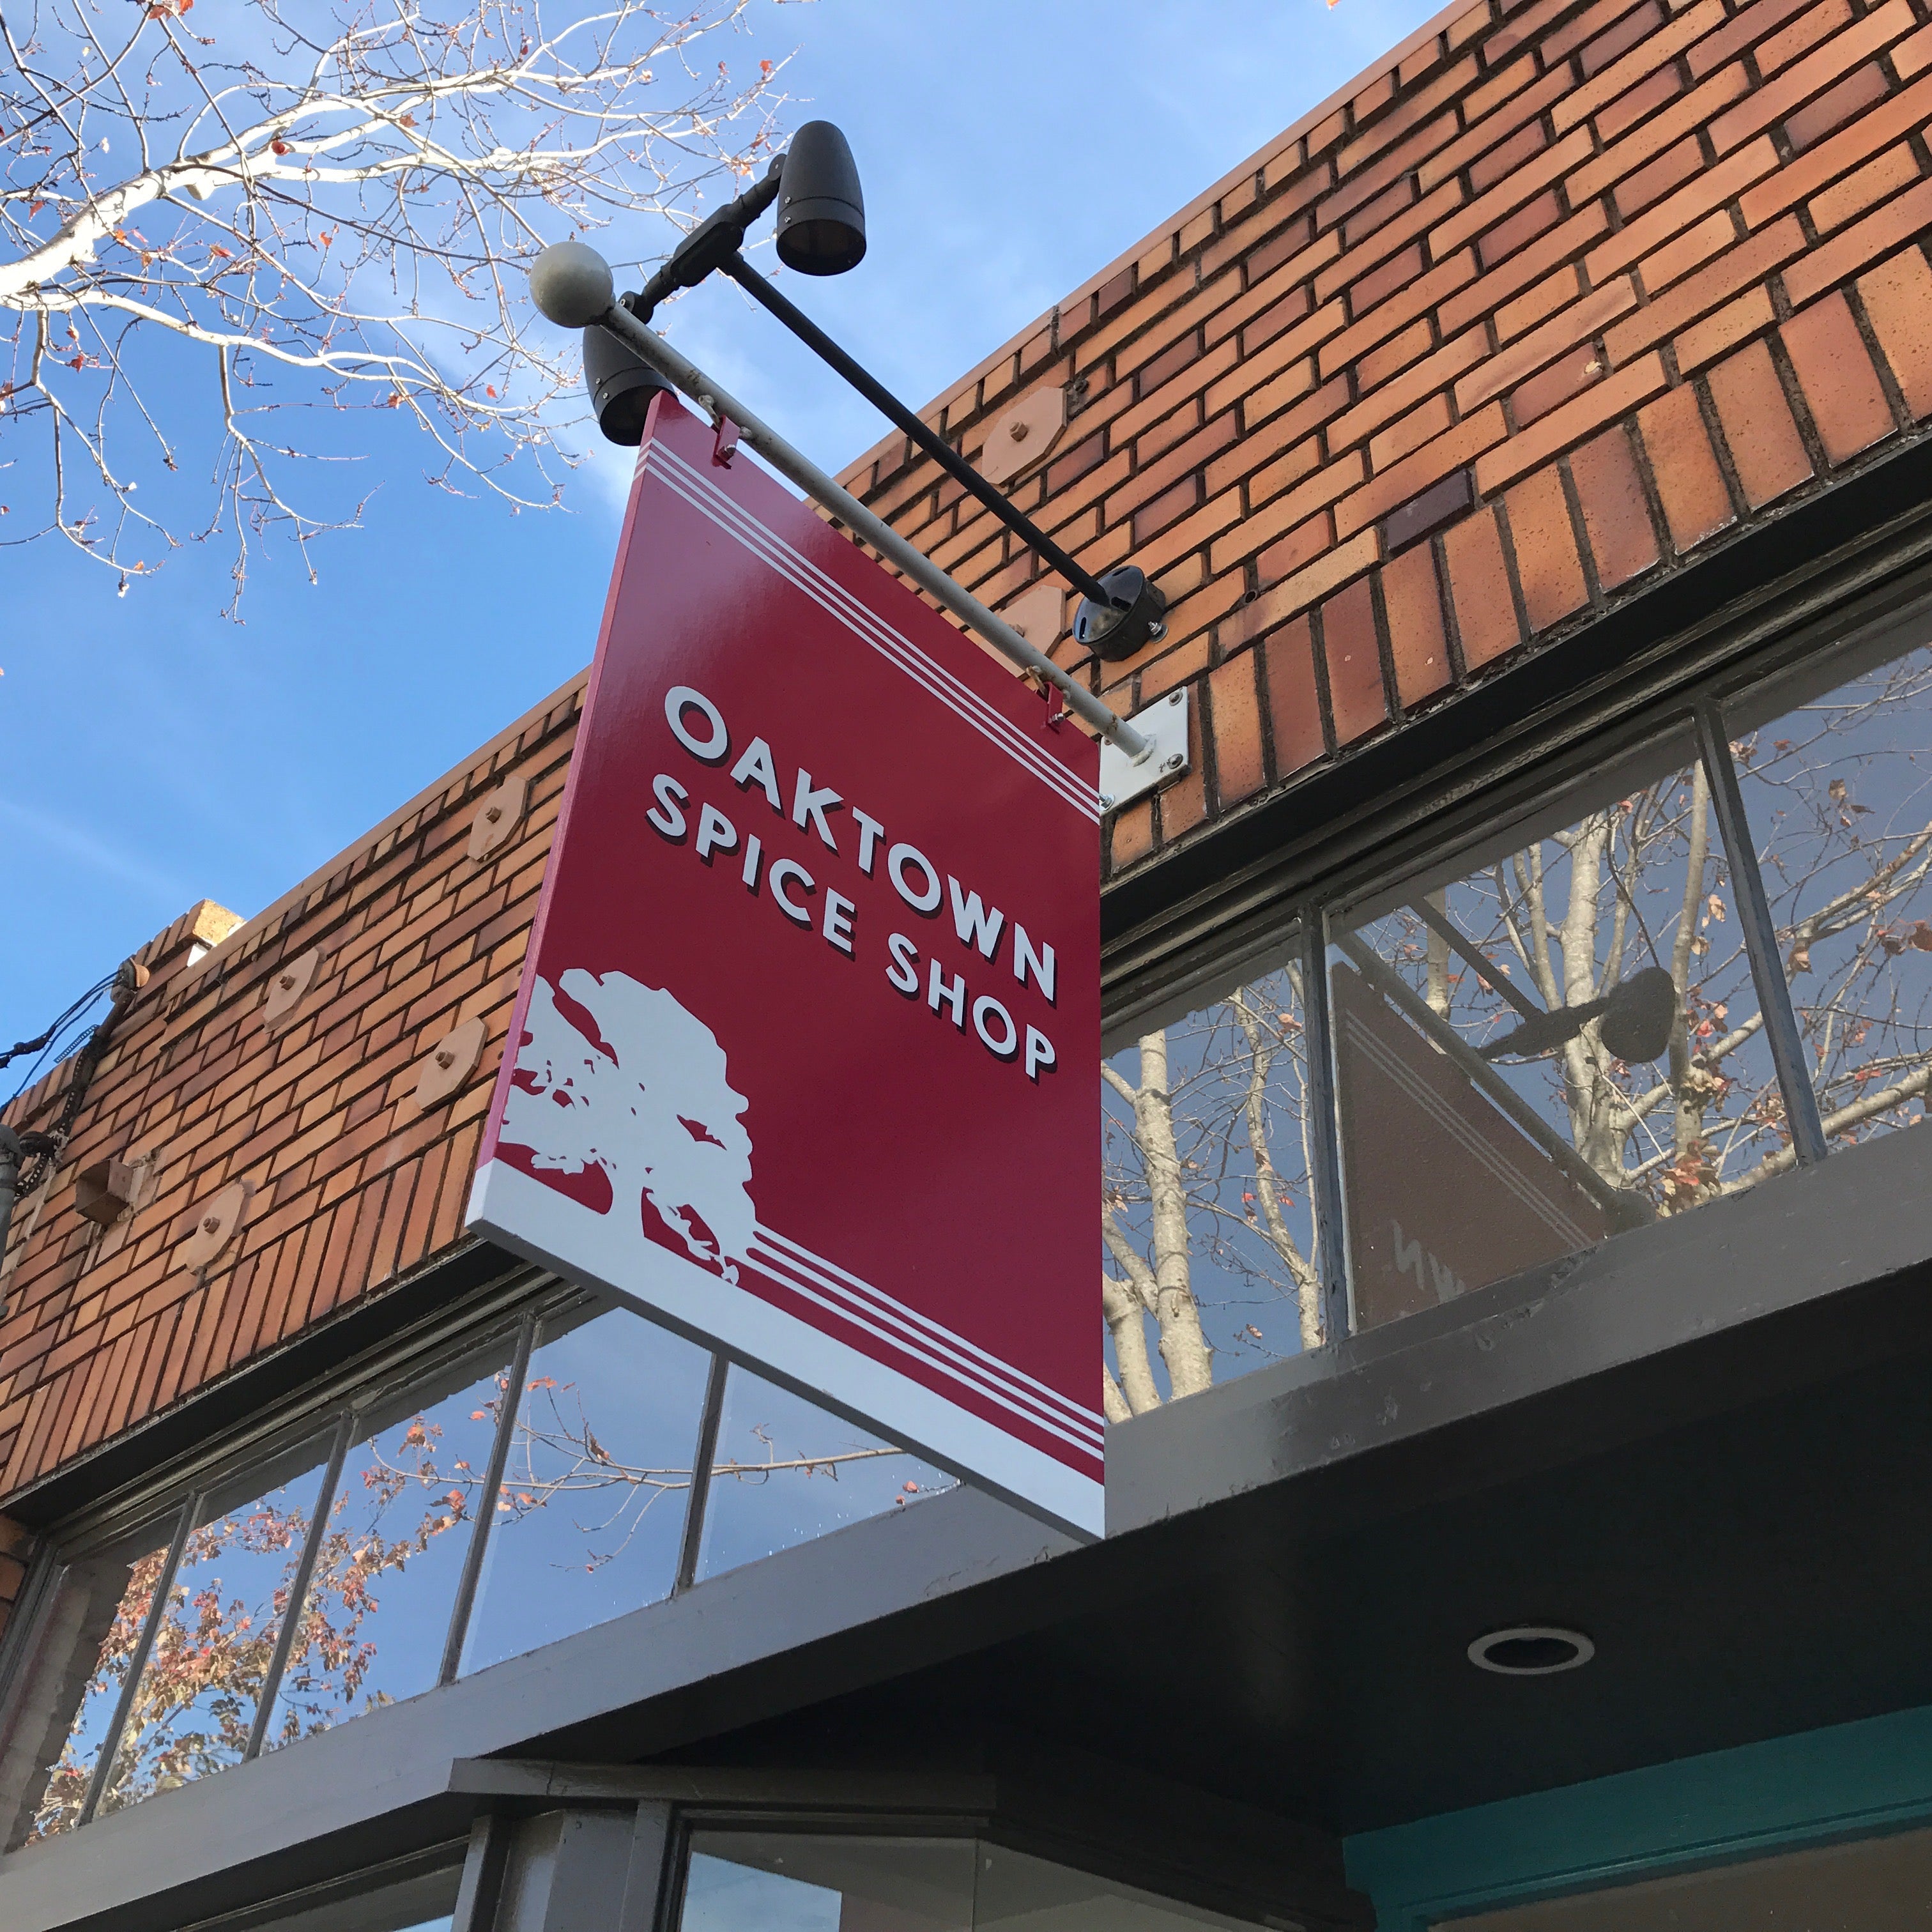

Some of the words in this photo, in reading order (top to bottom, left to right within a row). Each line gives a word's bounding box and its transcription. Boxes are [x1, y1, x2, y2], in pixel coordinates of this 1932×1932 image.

[646, 774, 857, 955] SPICE
[885, 933, 1056, 1079] SHOP
[664, 686, 1056, 1003] OAKTOWN
